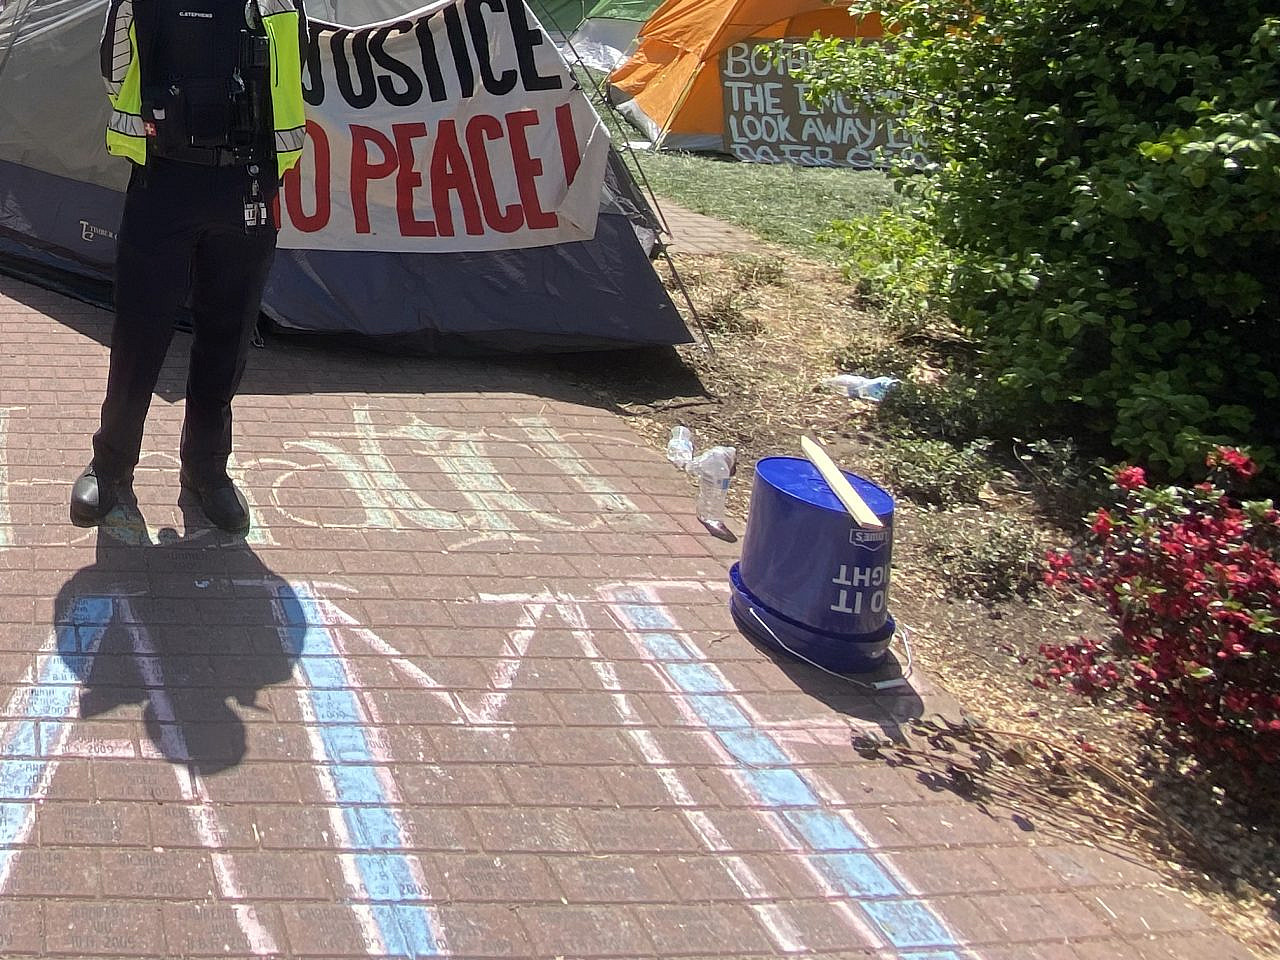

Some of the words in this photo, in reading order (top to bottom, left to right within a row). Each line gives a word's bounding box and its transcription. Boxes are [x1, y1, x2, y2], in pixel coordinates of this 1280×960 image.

[724, 81, 785, 115] THE
[729, 114, 798, 144] LOOK
[802, 116, 876, 149] AWAY
[273, 120, 331, 233] O
[832, 564, 888, 587] IGHT
[830, 589, 863, 614] IT
[870, 589, 887, 613] O
